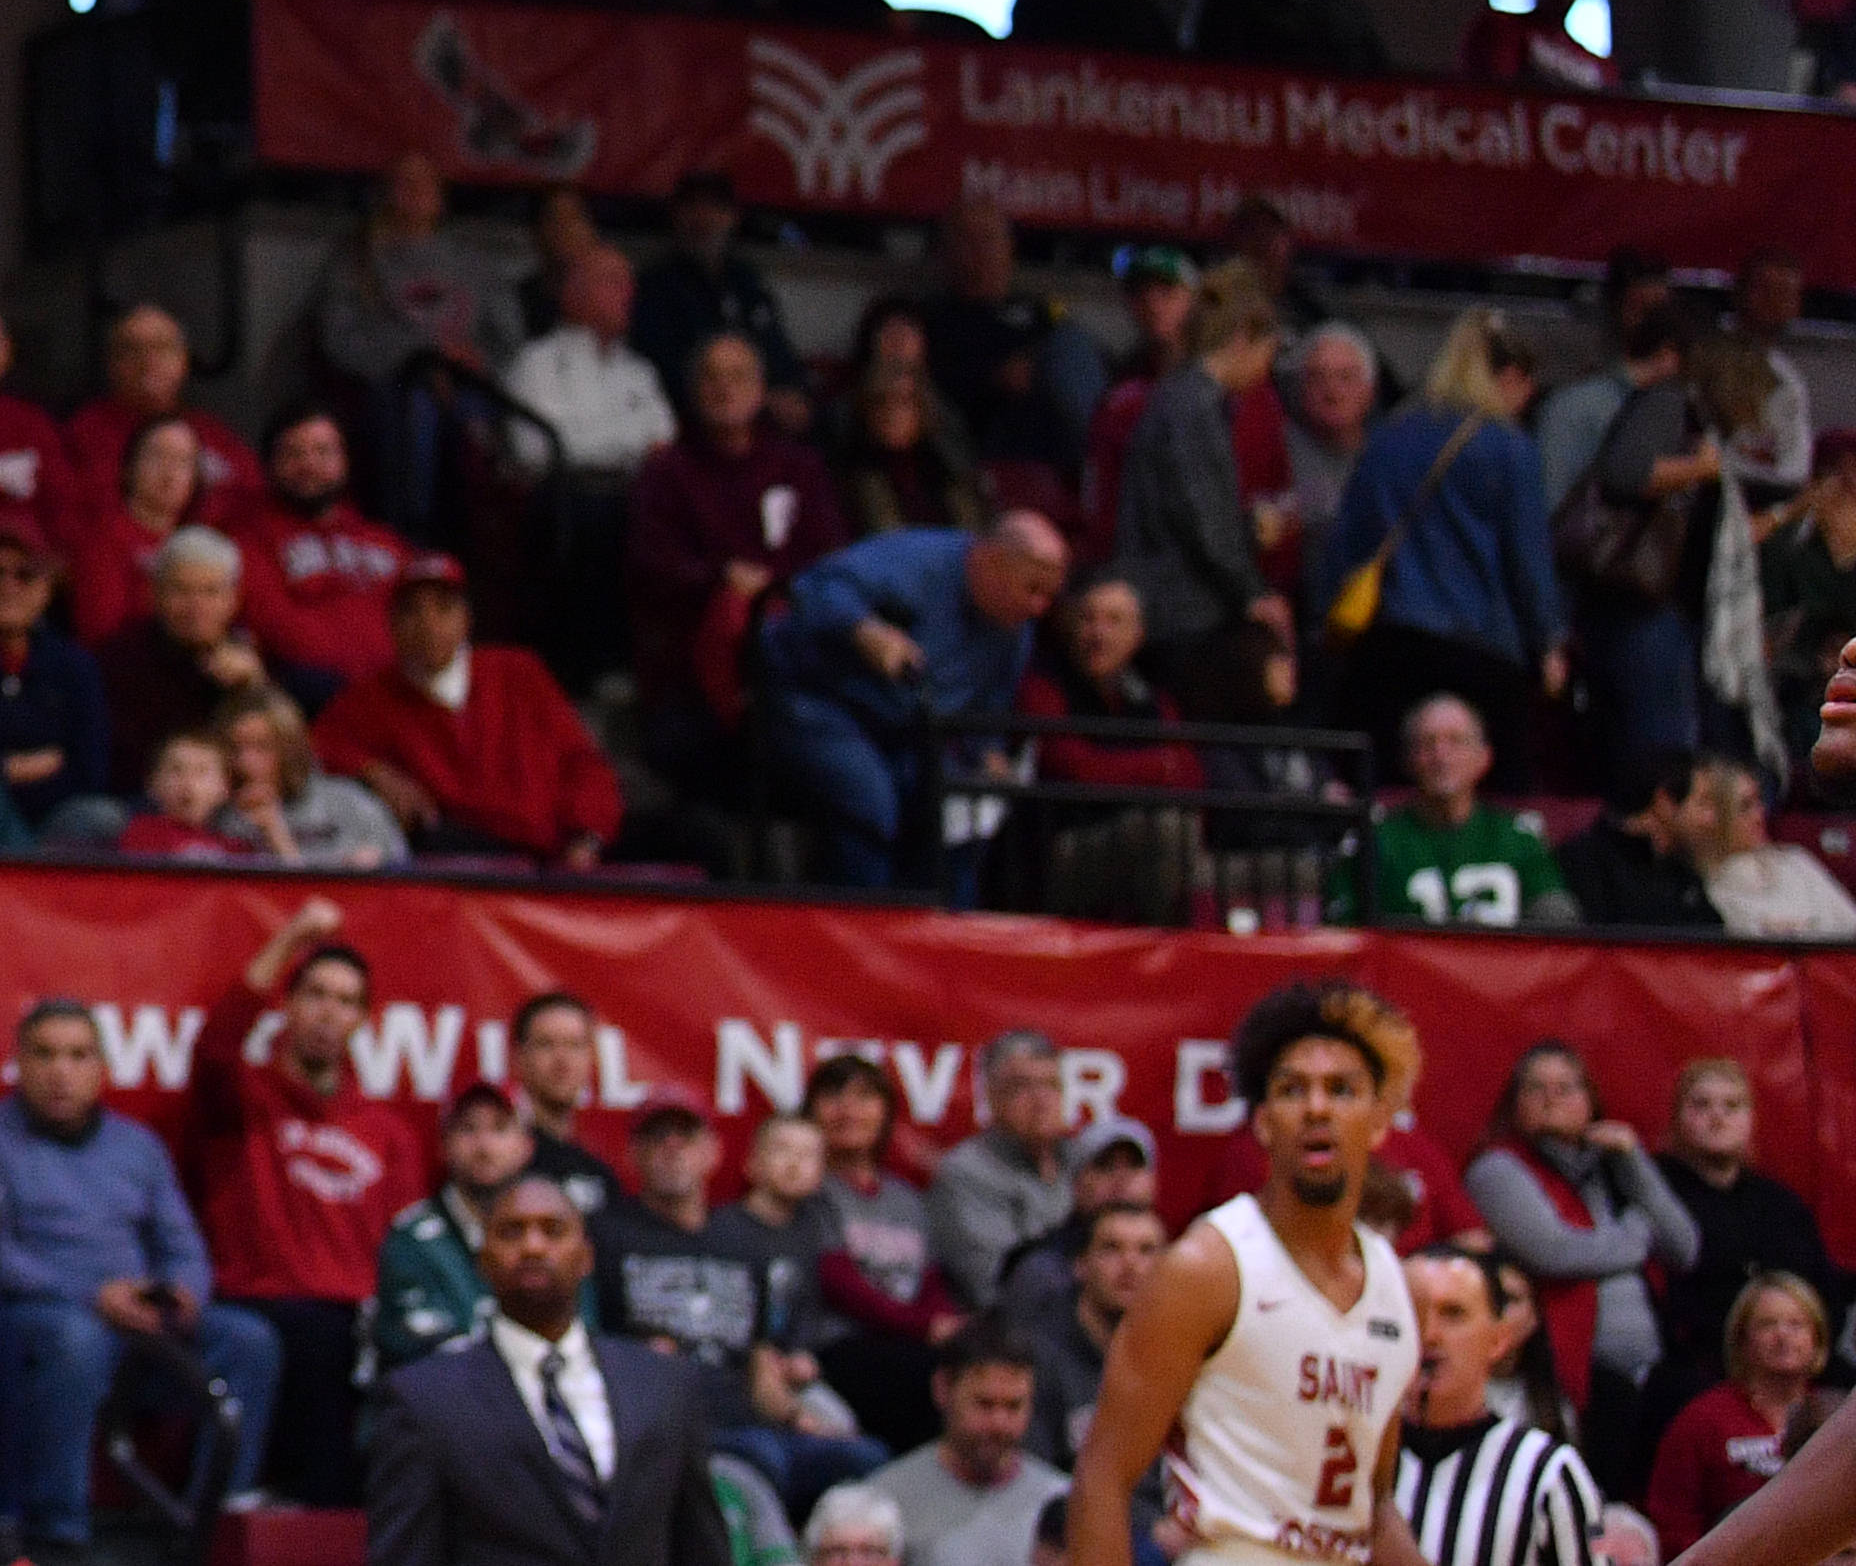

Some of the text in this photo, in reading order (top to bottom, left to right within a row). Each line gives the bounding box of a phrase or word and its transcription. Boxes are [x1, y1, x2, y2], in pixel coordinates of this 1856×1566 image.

[959, 52, 1751, 189] Lankenau Medical Center
[1315, 1426, 1358, 1508] 2
